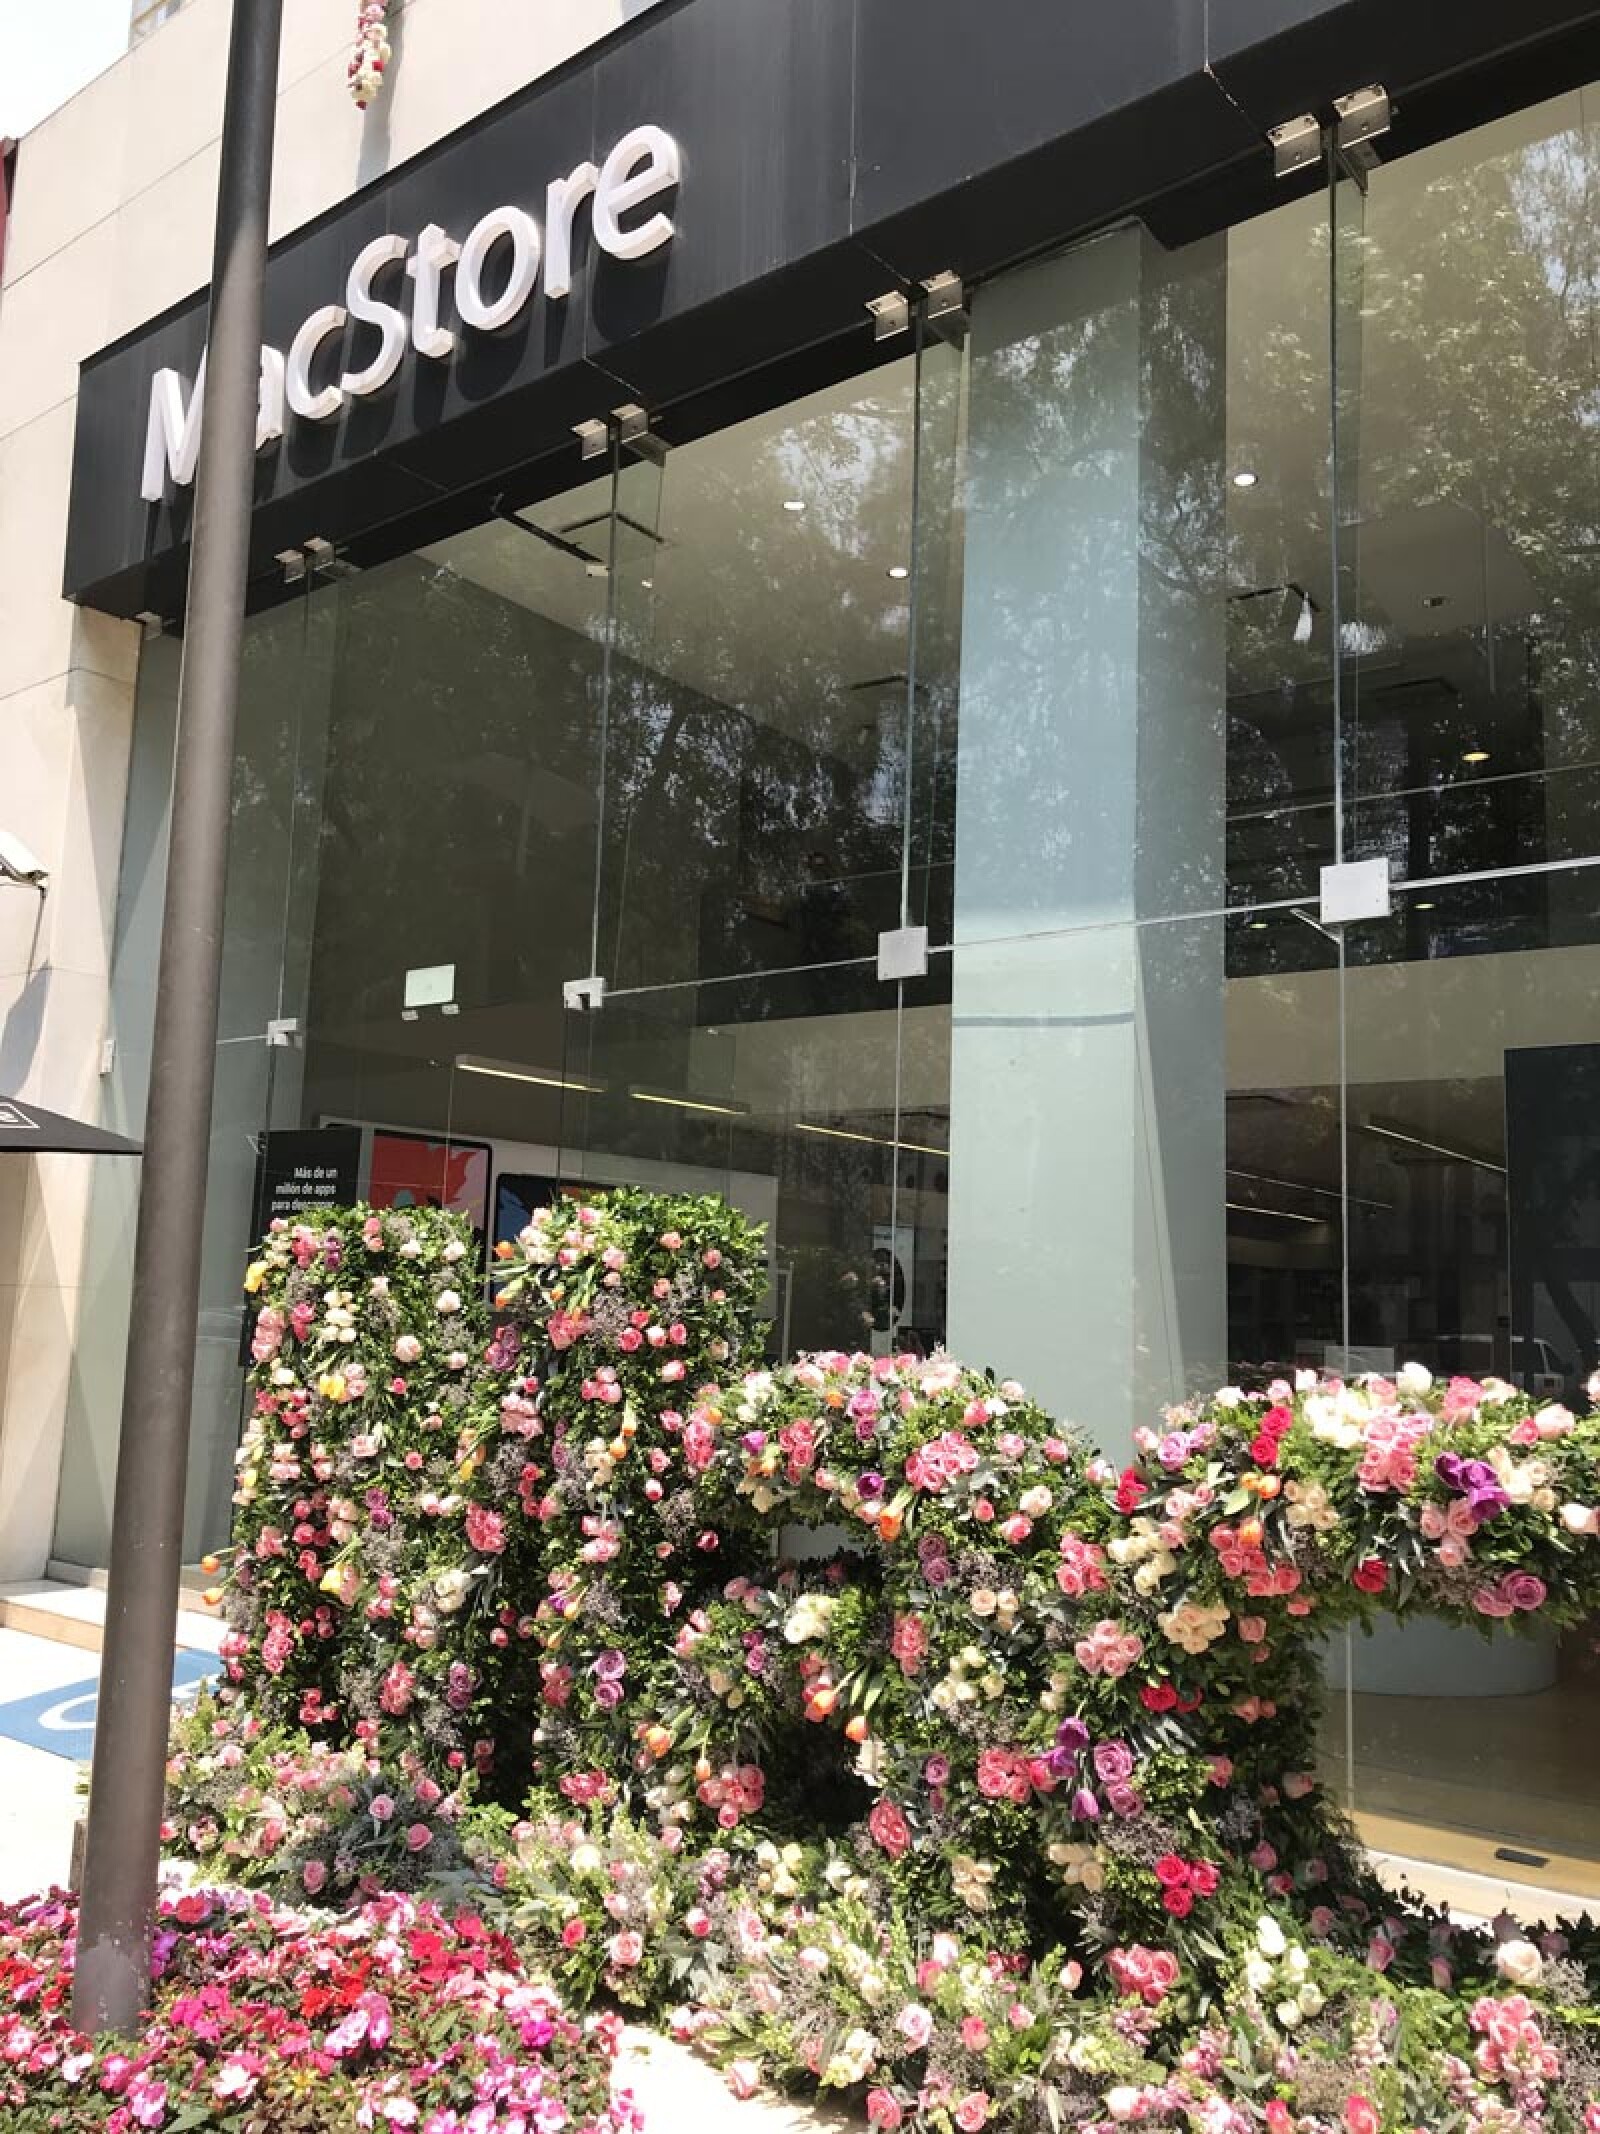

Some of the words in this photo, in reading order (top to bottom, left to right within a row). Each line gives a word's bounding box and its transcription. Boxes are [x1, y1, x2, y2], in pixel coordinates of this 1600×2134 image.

[293, 1166, 312, 1179] Más
[314, 1166, 325, 1179] de
[326, 1167, 338, 1179] un
[276, 1182, 301, 1195] millón
[302, 1182, 313, 1195] de
[314, 1184, 337, 1197] apps
[272, 1200, 291, 1212] para
